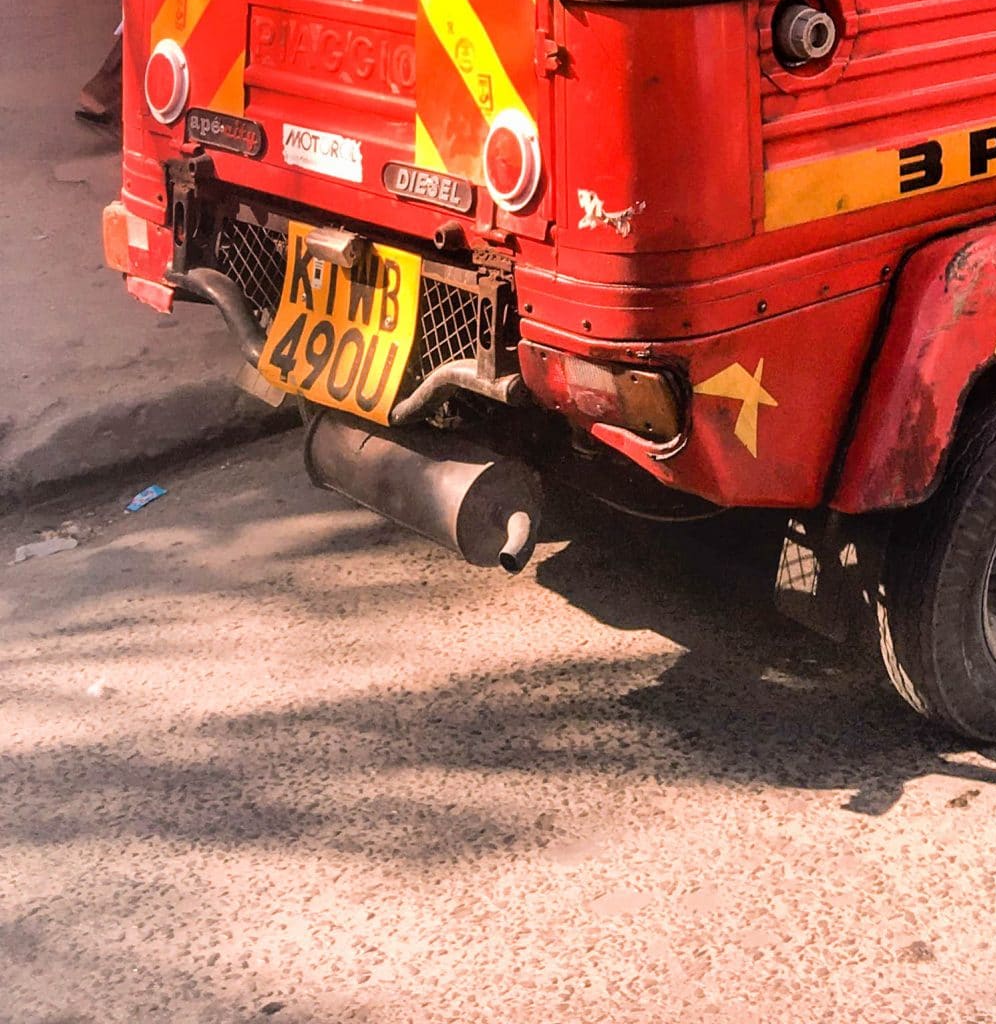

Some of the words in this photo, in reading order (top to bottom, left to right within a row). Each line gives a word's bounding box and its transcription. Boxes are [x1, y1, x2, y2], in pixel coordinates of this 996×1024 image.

[395, 167, 462, 206] DIESEL
[898, 139, 942, 193] 3
[269, 313, 399, 413] 490U
